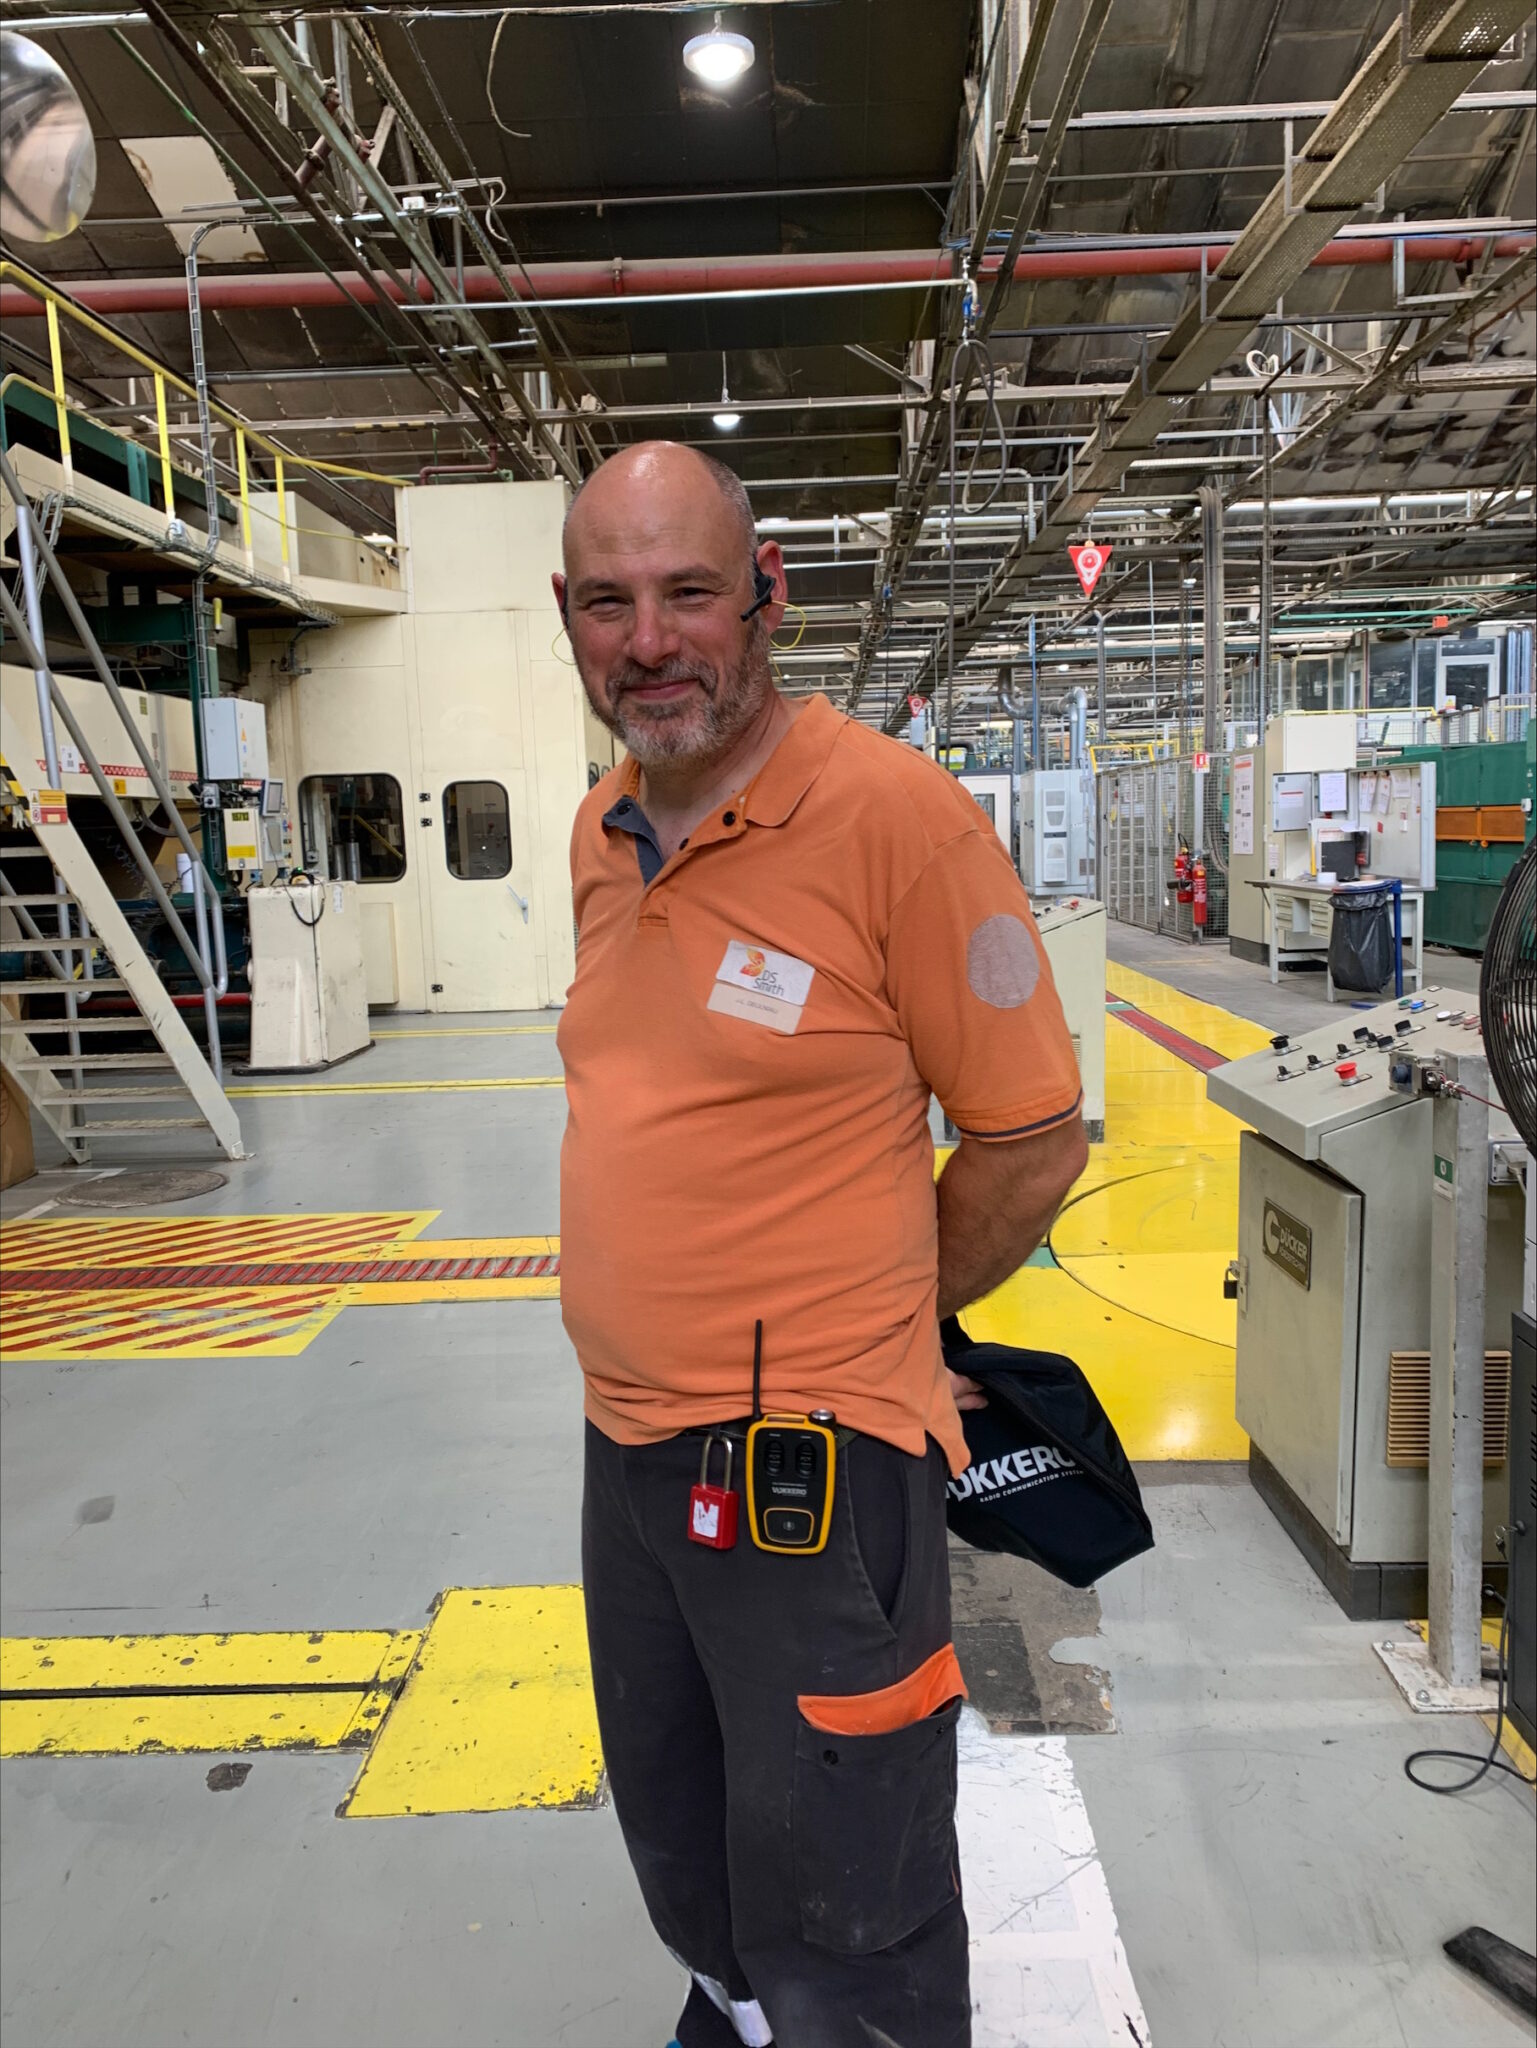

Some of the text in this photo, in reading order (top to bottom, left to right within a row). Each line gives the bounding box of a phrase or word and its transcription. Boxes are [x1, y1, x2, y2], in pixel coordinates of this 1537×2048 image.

[753, 977, 785, 996] Smith
[762, 969, 779, 984] DS
[945, 1446, 1076, 1502] OKKER
[980, 1493, 1001, 1503] RADIO
[1002, 1473, 1060, 1496] COMMUNICATION
